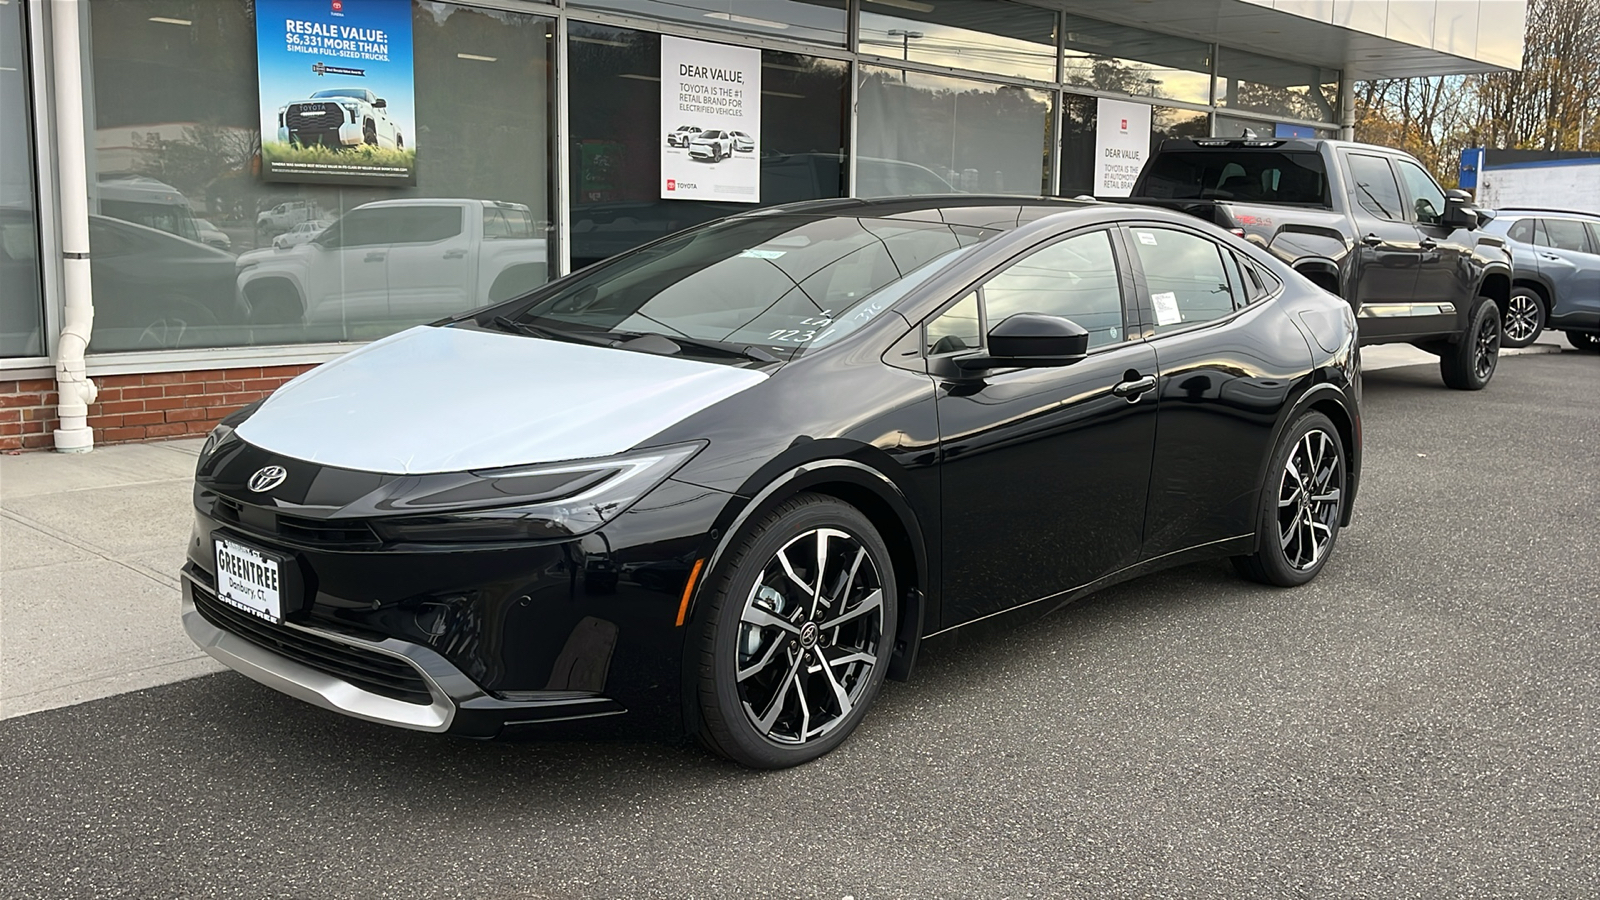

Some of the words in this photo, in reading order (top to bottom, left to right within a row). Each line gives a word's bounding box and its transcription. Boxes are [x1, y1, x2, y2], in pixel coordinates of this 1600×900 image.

[286, 19, 338, 38] RESALE
[340, 25, 388, 44] VALUE:
[286, 32, 322, 47] $6,331
[323, 38, 356, 51] MORE
[358, 42, 388, 54] THAN
[287, 44, 318, 55] SIMILAR
[320, 47, 360, 59] FULL-SIZED
[361, 52, 390, 62] TRUCKS.
[680, 64, 708, 79] DEAR
[710, 68, 745, 85] VALUE,
[679, 83, 709, 95] TOYOTA
[711, 87, 718, 96] IS
[719, 88, 733, 98] THE
[734, 90, 742, 98] #1
[299, 104, 326, 112] TOYOTA
[679, 93, 702, 104] RETAIL
[703, 96, 727, 107] BRAND
[728, 99, 742, 108] FOR
[679, 103, 715, 114] ELECTRIFIED
[716, 107, 743, 117] VEHICLES.
[1105, 148, 1121, 159] DEAR
[1121, 149, 1140, 161] VALUE,
[1104, 163, 1124, 173] TOYOTA
[1124, 165, 1129, 174] IS
[1130, 166, 1139, 174] THE
[677, 182, 698, 190] TOYOTA
[1103, 180, 1120, 189] RETAIL
[218, 549, 278, 592] GREENTREE
[228, 577, 256, 600] Danbury,
[217, 594, 278, 625] GREENTREE
